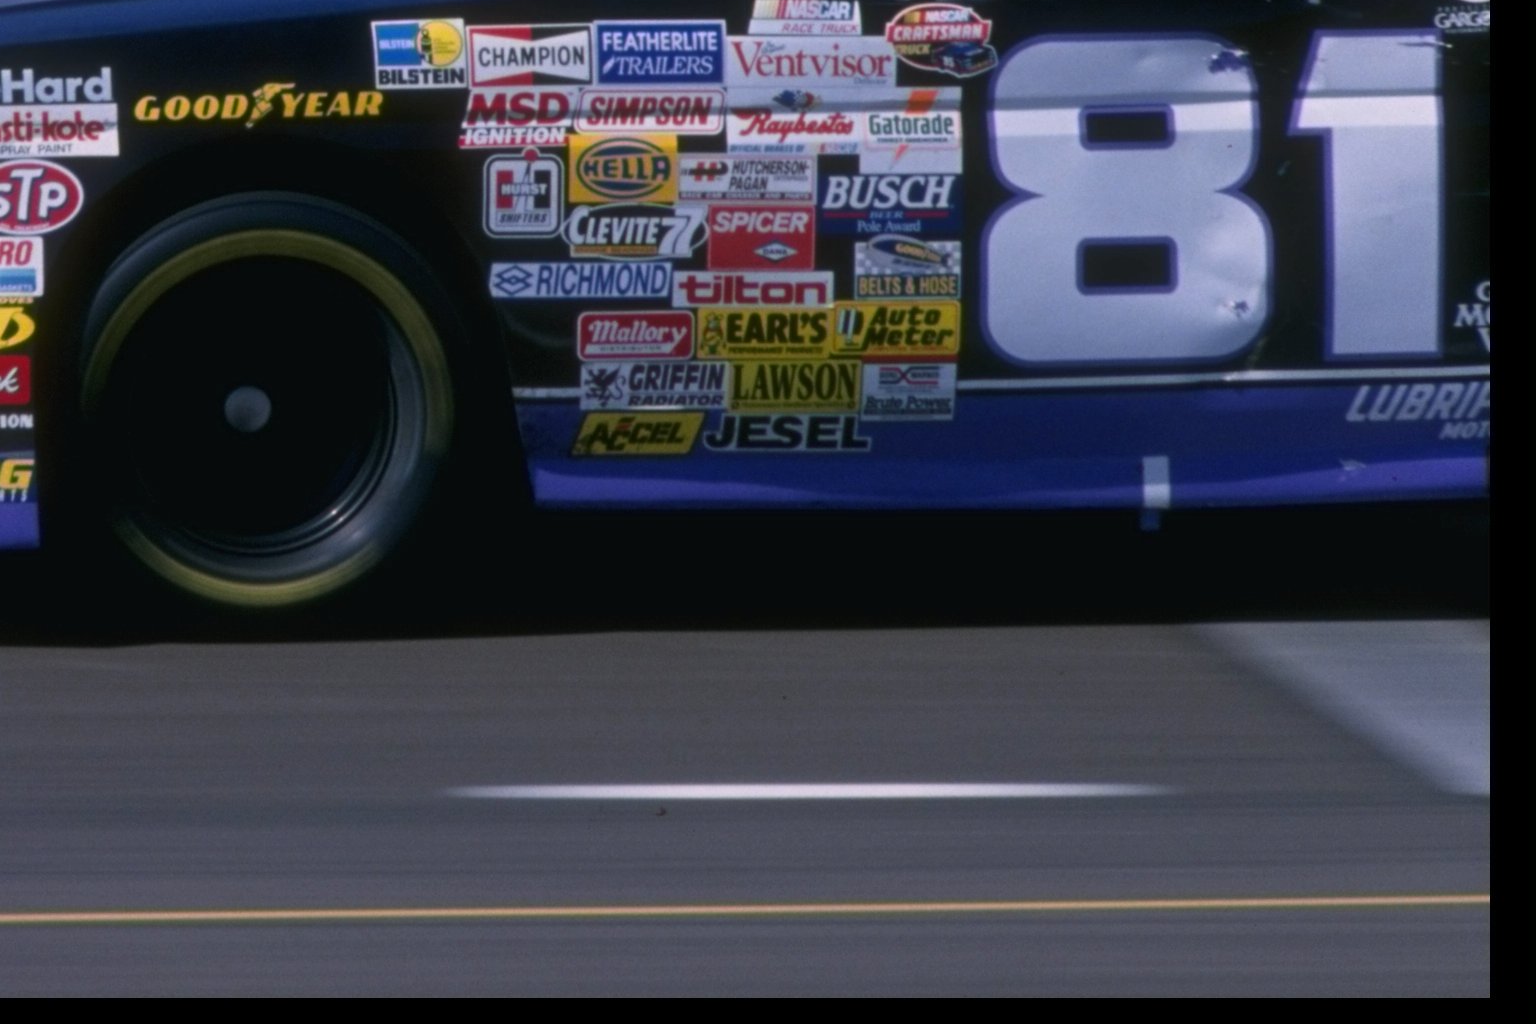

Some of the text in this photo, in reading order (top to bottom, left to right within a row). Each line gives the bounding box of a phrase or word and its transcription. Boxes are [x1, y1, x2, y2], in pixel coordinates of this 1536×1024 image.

[787, 0, 852, 19] NASCAR
[781, 23, 858, 33] RACE TRUCK
[892, 24, 983, 42] CRAFTSMAN
[602, 31, 718, 52] FEATHERLITE
[478, 45, 585, 67] CHAMPION
[614, 55, 714, 76] TRAILERS
[731, 40, 892, 78] Ventvisor
[378, 67, 465, 85] BILSTEIN
[133, 83, 384, 128] GOODYEAR
[466, 92, 570, 126] MSD
[586, 95, 713, 127] SIMPSON
[464, 126, 565, 144] IGNITION
[731, 107, 855, 143] Raybestos
[868, 114, 955, 136] Gatorade
[37, 143, 74, 154] PAINT
[582, 156, 671, 182] HELLA
[500, 183, 548, 196] HURST
[729, 176, 769, 191] PAGAN
[822, 175, 956, 209] BUSCH
[980, 29, 1443, 368] 81
[499, 212, 548, 224] SHIFTERS
[568, 206, 660, 245] CLEVITE
[712, 211, 810, 234] SPICER
[857, 219, 922, 233] Pole Award
[536, 264, 668, 297] RICHMOND
[677, 274, 829, 304] tilton
[858, 275, 957, 295] BELTS & HOSE
[726, 312, 827, 343] EARL'S
[870, 306, 942, 327] Auto
[587, 320, 687, 345] Mallory
[864, 326, 954, 347] Meter
[628, 363, 726, 391] GRIFFIN
[732, 362, 859, 400] LAWSON
[627, 394, 725, 407] RADIATOR
[865, 395, 953, 409] Brute Power
[703, 414, 870, 451] JESEL
